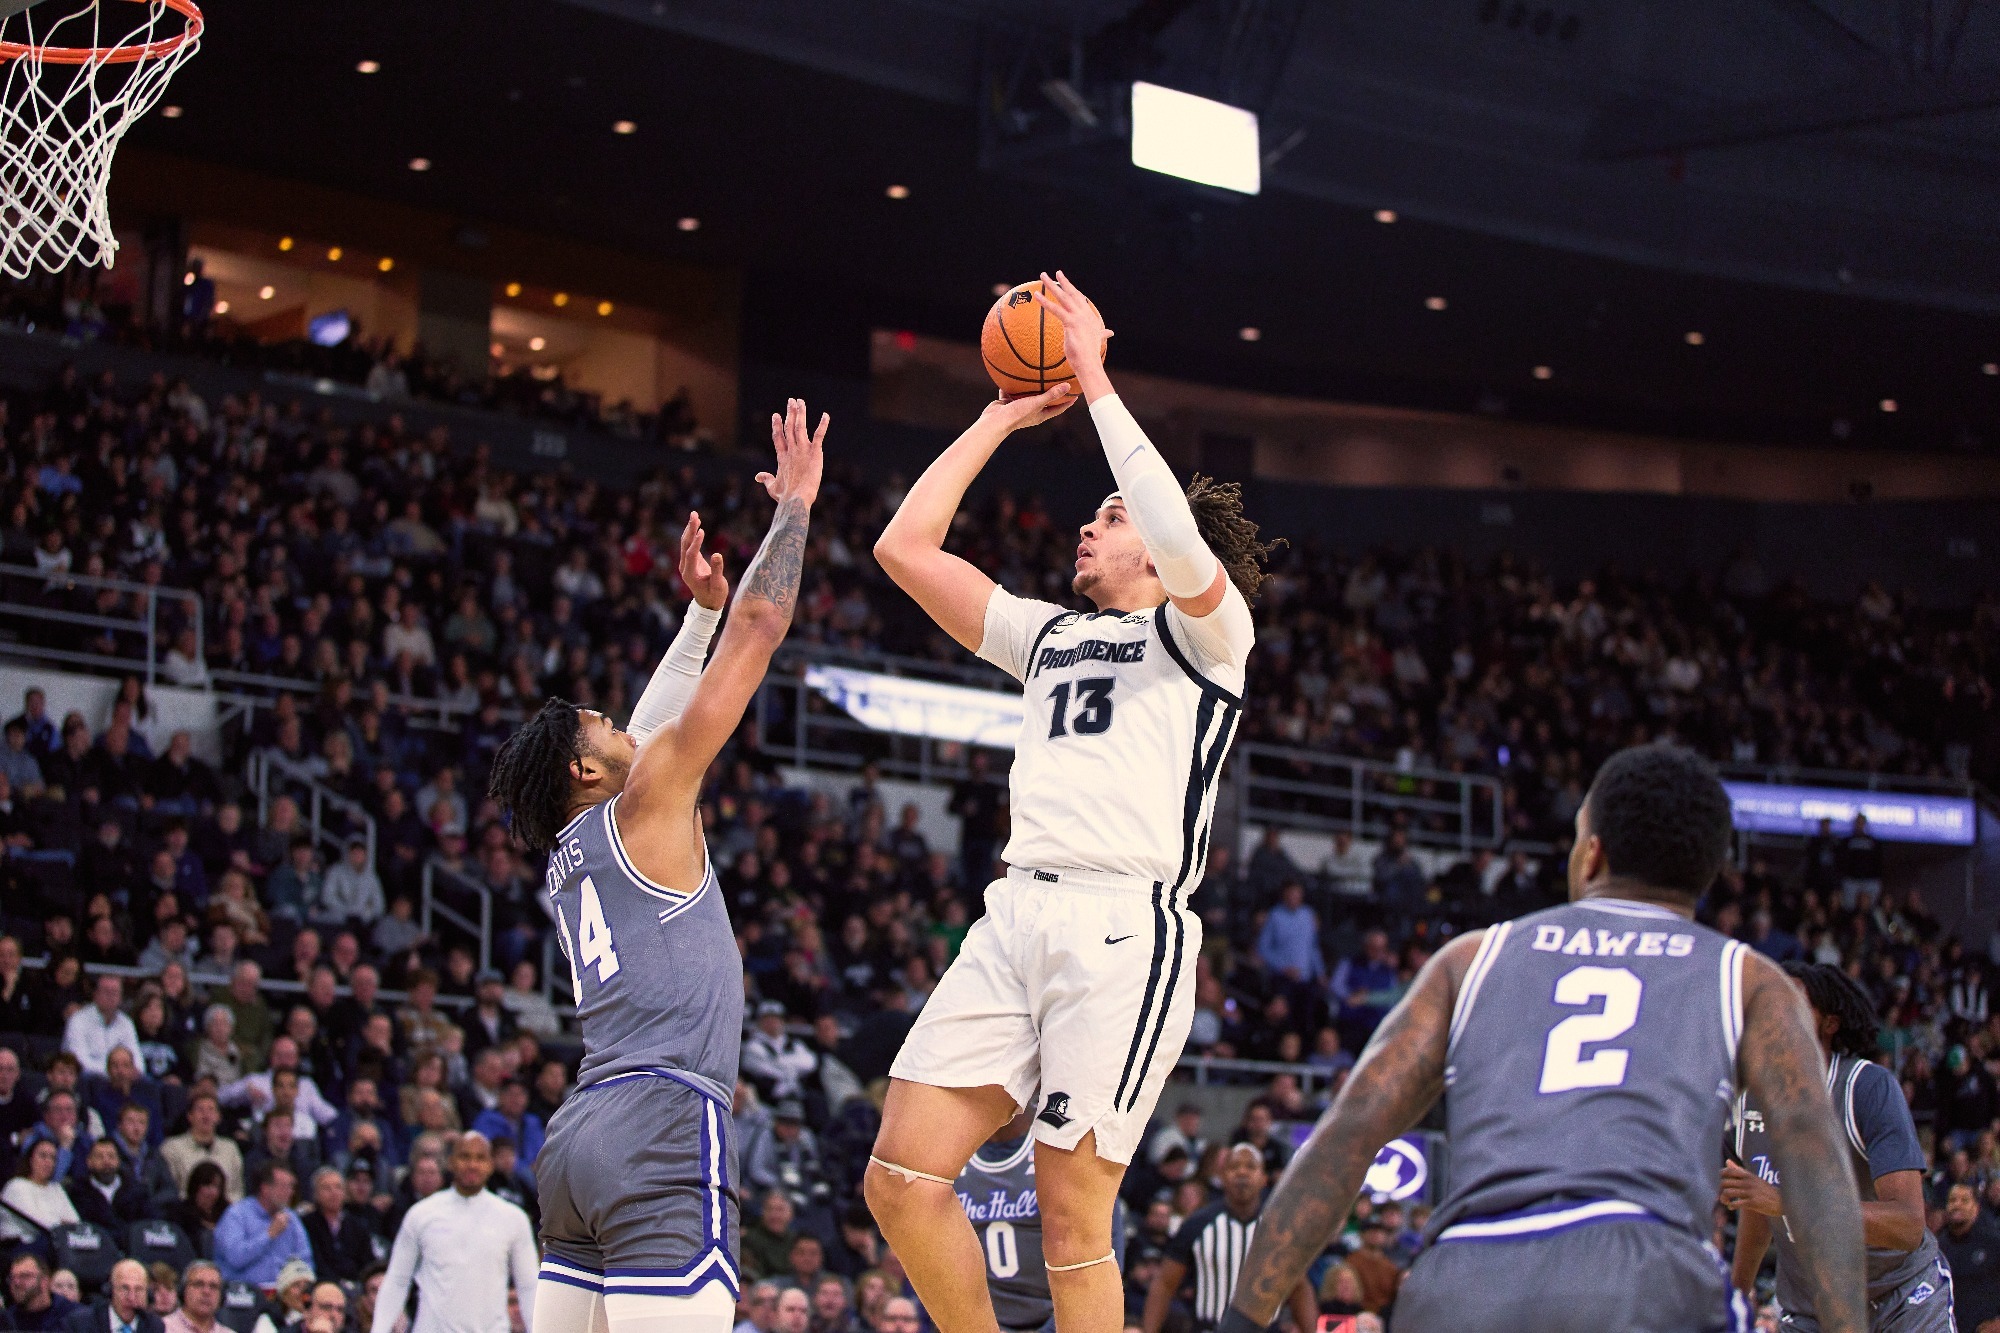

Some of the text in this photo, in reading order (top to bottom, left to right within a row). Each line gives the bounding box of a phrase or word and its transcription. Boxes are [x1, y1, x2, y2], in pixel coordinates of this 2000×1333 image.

[1033, 639, 1147, 680] PROVIDENCE
[1044, 676, 1117, 742] 13
[547, 837, 585, 897] DAVIS
[556, 873, 622, 1009] 14
[1531, 924, 1696, 957] DAWES
[1537, 964, 1644, 1095] 2
[987, 1189, 1037, 1219] Hall
[985, 1221, 1020, 1279] 0
